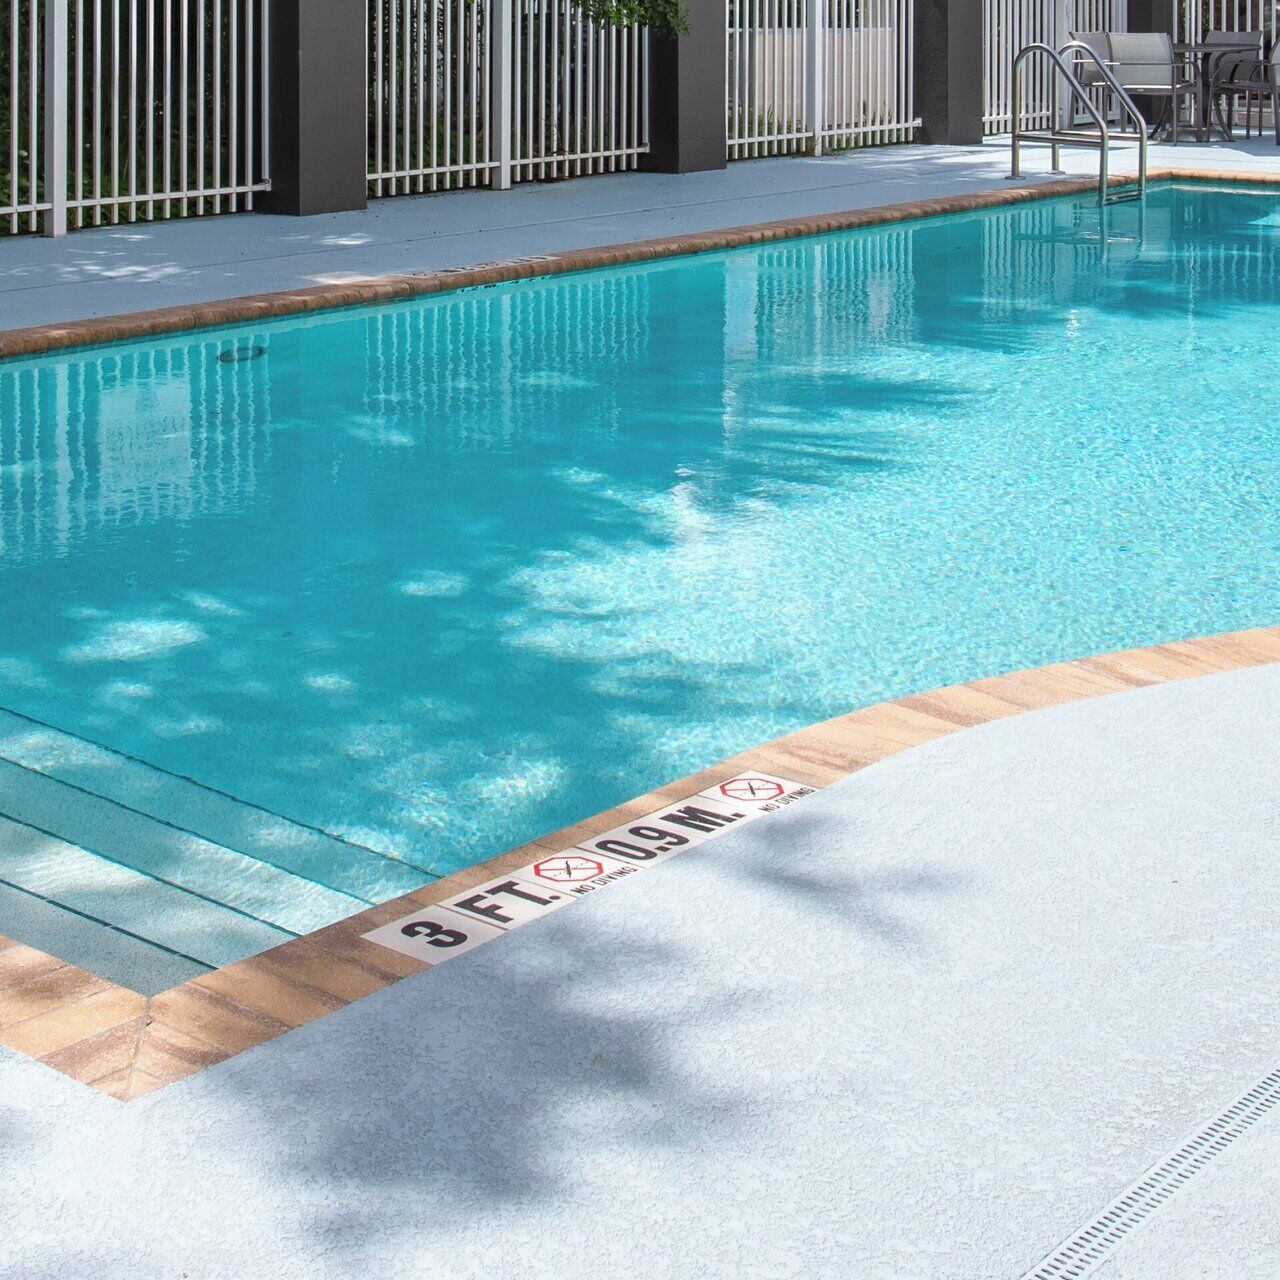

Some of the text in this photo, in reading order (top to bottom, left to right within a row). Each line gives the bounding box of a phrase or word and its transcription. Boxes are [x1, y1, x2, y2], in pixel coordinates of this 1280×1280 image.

[758, 787, 815, 814] NO DIVING
[595, 805, 746, 861] 0.9 M.
[570, 866, 638, 896] NO DIVING
[400, 880, 562, 948] 3 FT.
